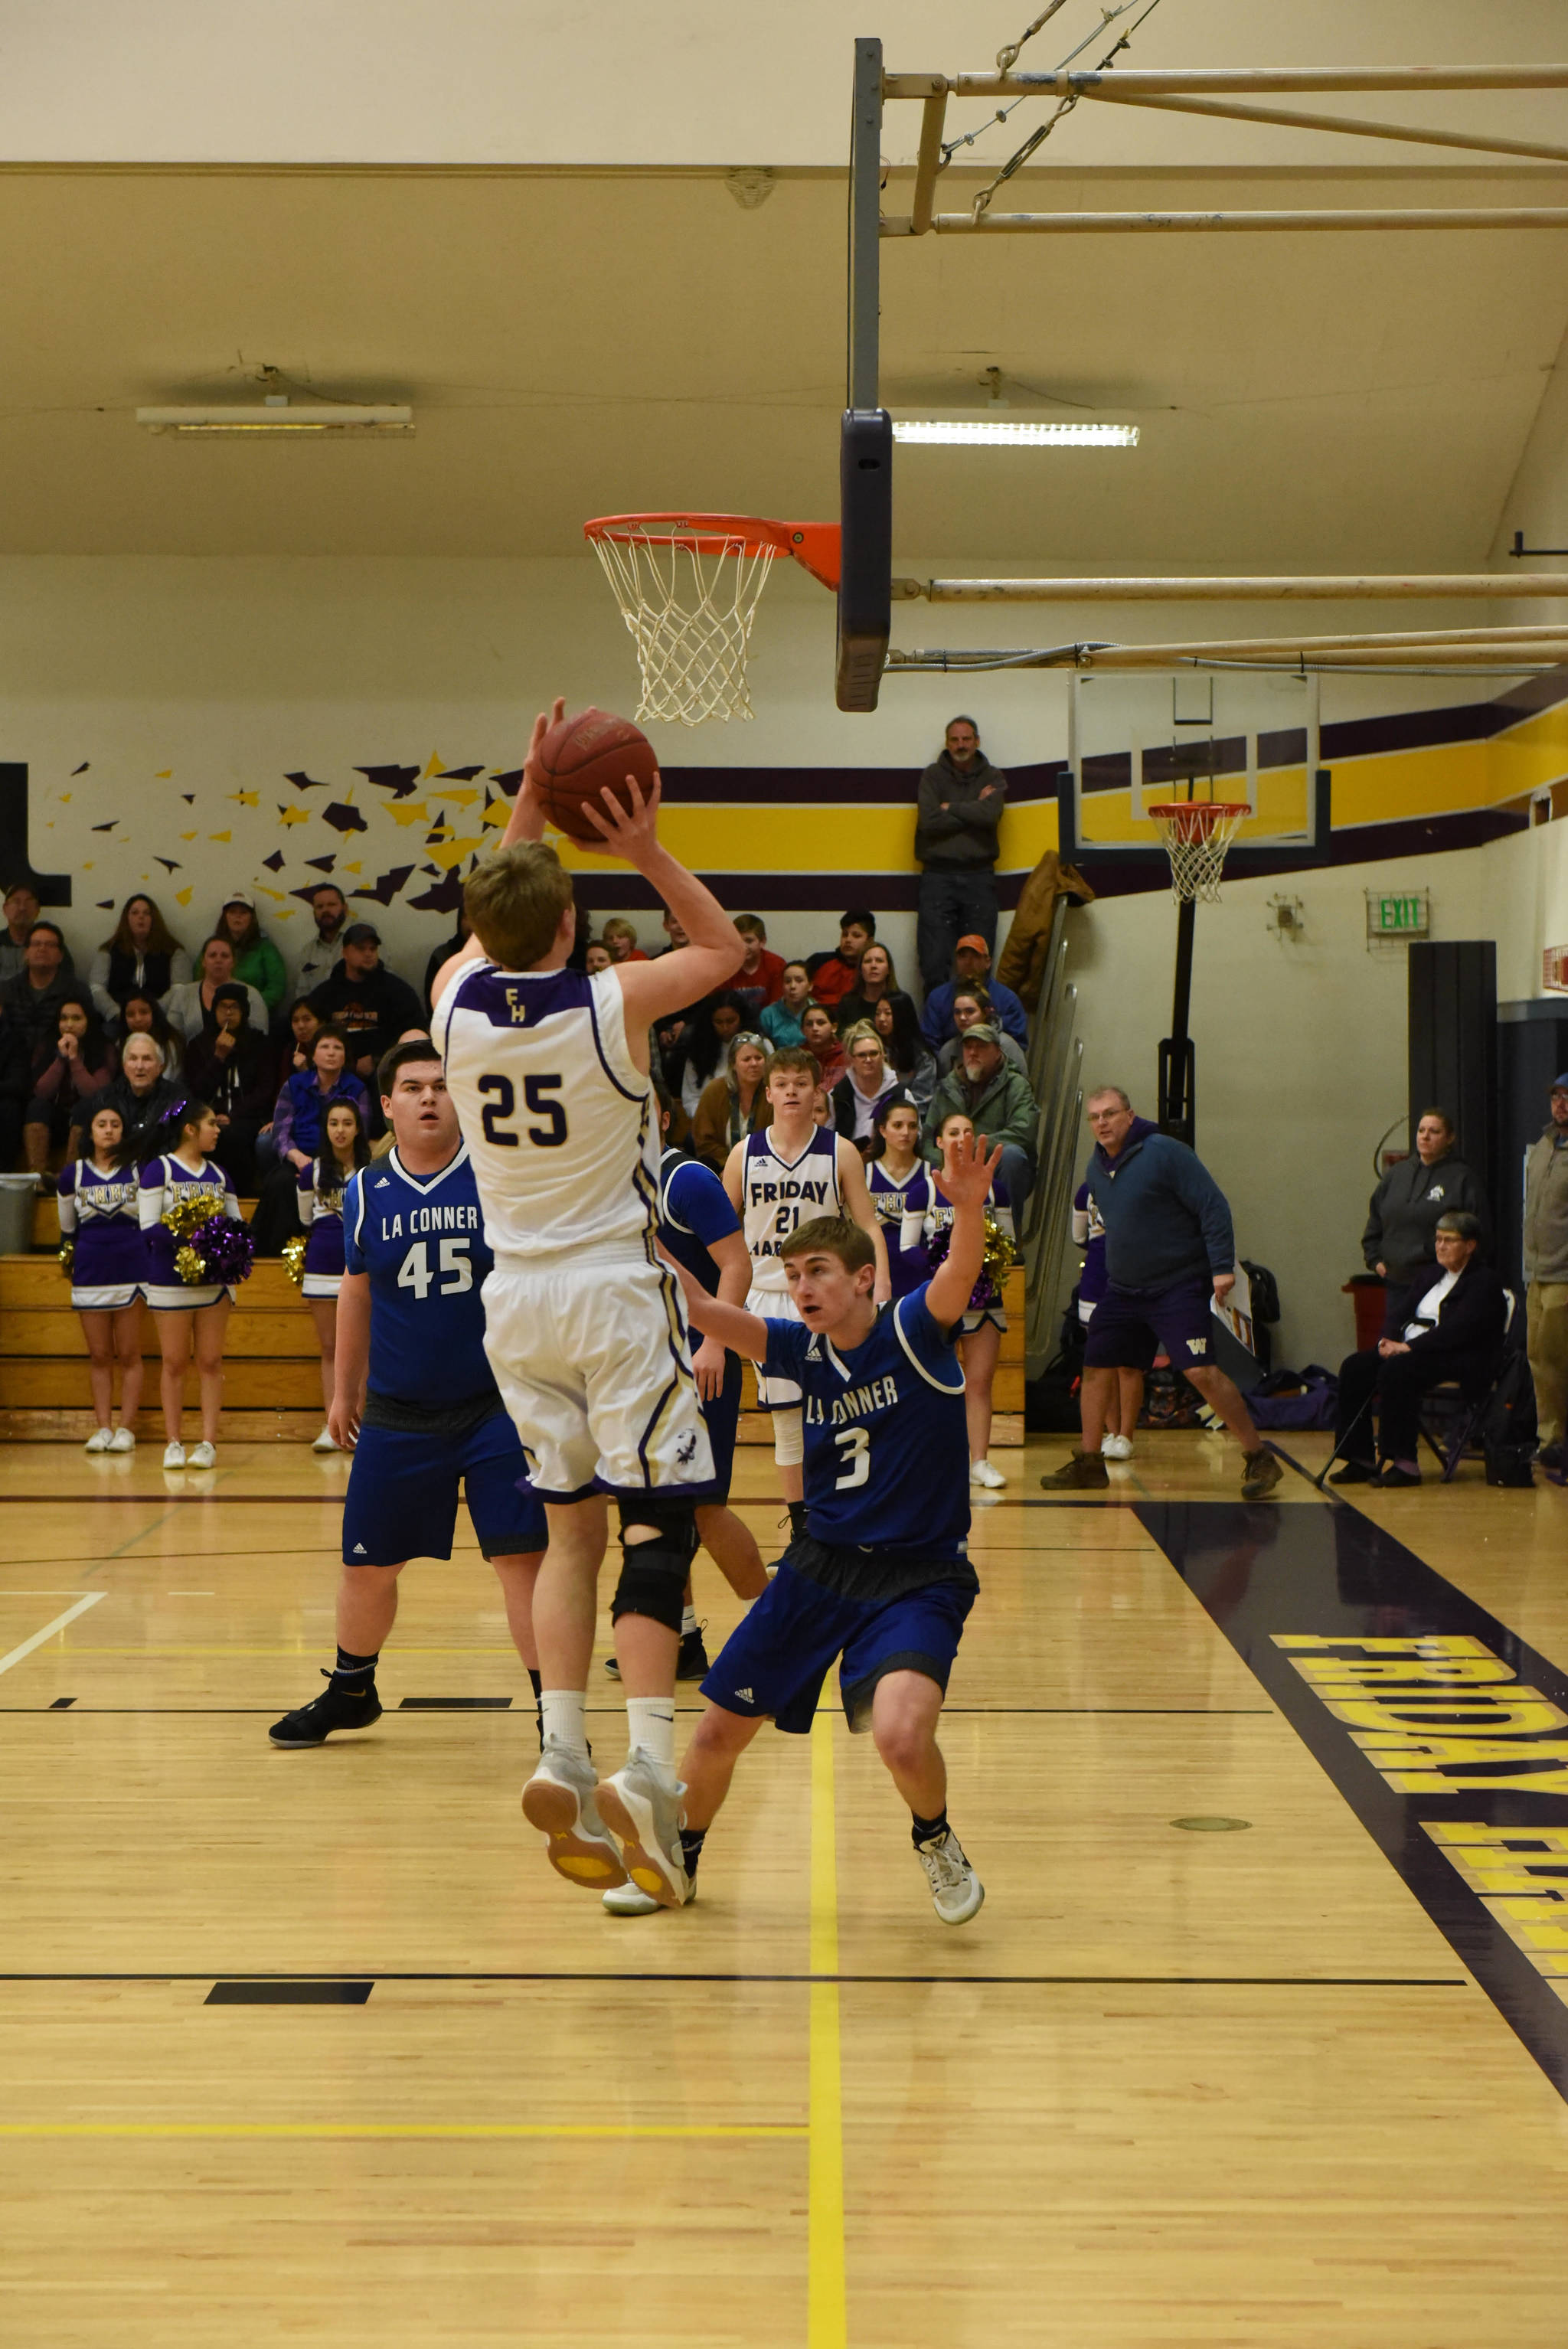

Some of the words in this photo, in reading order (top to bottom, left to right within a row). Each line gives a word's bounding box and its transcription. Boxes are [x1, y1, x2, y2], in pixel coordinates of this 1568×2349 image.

[1380, 897, 1420, 929] EXIT
[478, 1073, 567, 1147] 25
[750, 1180, 828, 1207] FRIDAY
[382, 1214, 403, 1241] LA
[410, 1206, 478, 1234] CONNER
[776, 1206, 799, 1234] 21
[397, 1237, 474, 1299] 45
[1186, 1338, 1207, 1355] W
[834, 1426, 871, 1491] 3
